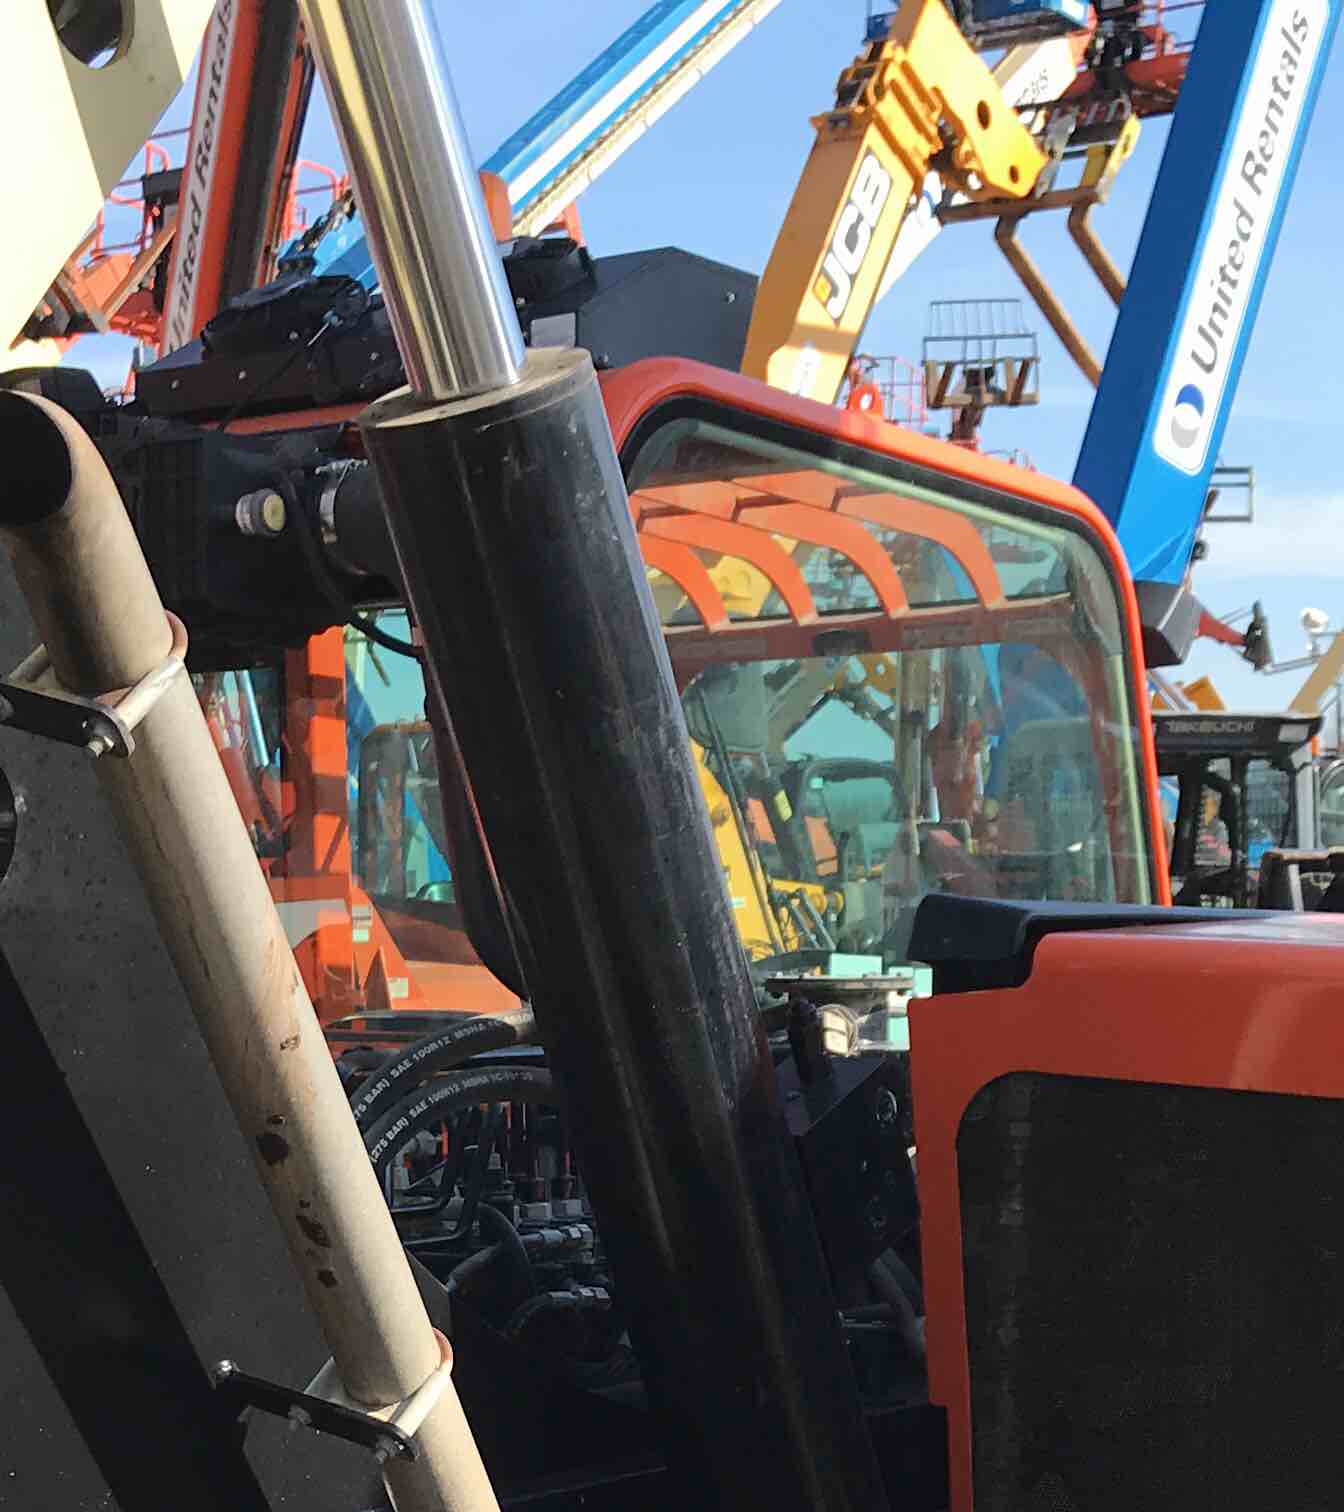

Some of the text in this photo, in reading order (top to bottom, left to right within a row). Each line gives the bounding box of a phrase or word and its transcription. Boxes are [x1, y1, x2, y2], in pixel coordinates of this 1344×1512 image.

[814, 150, 894, 325] JCB
[1190, 9, 1310, 375] United Rentals
[390, 1058, 414, 1079] SAE
[409, 1100, 428, 1119] SAE
